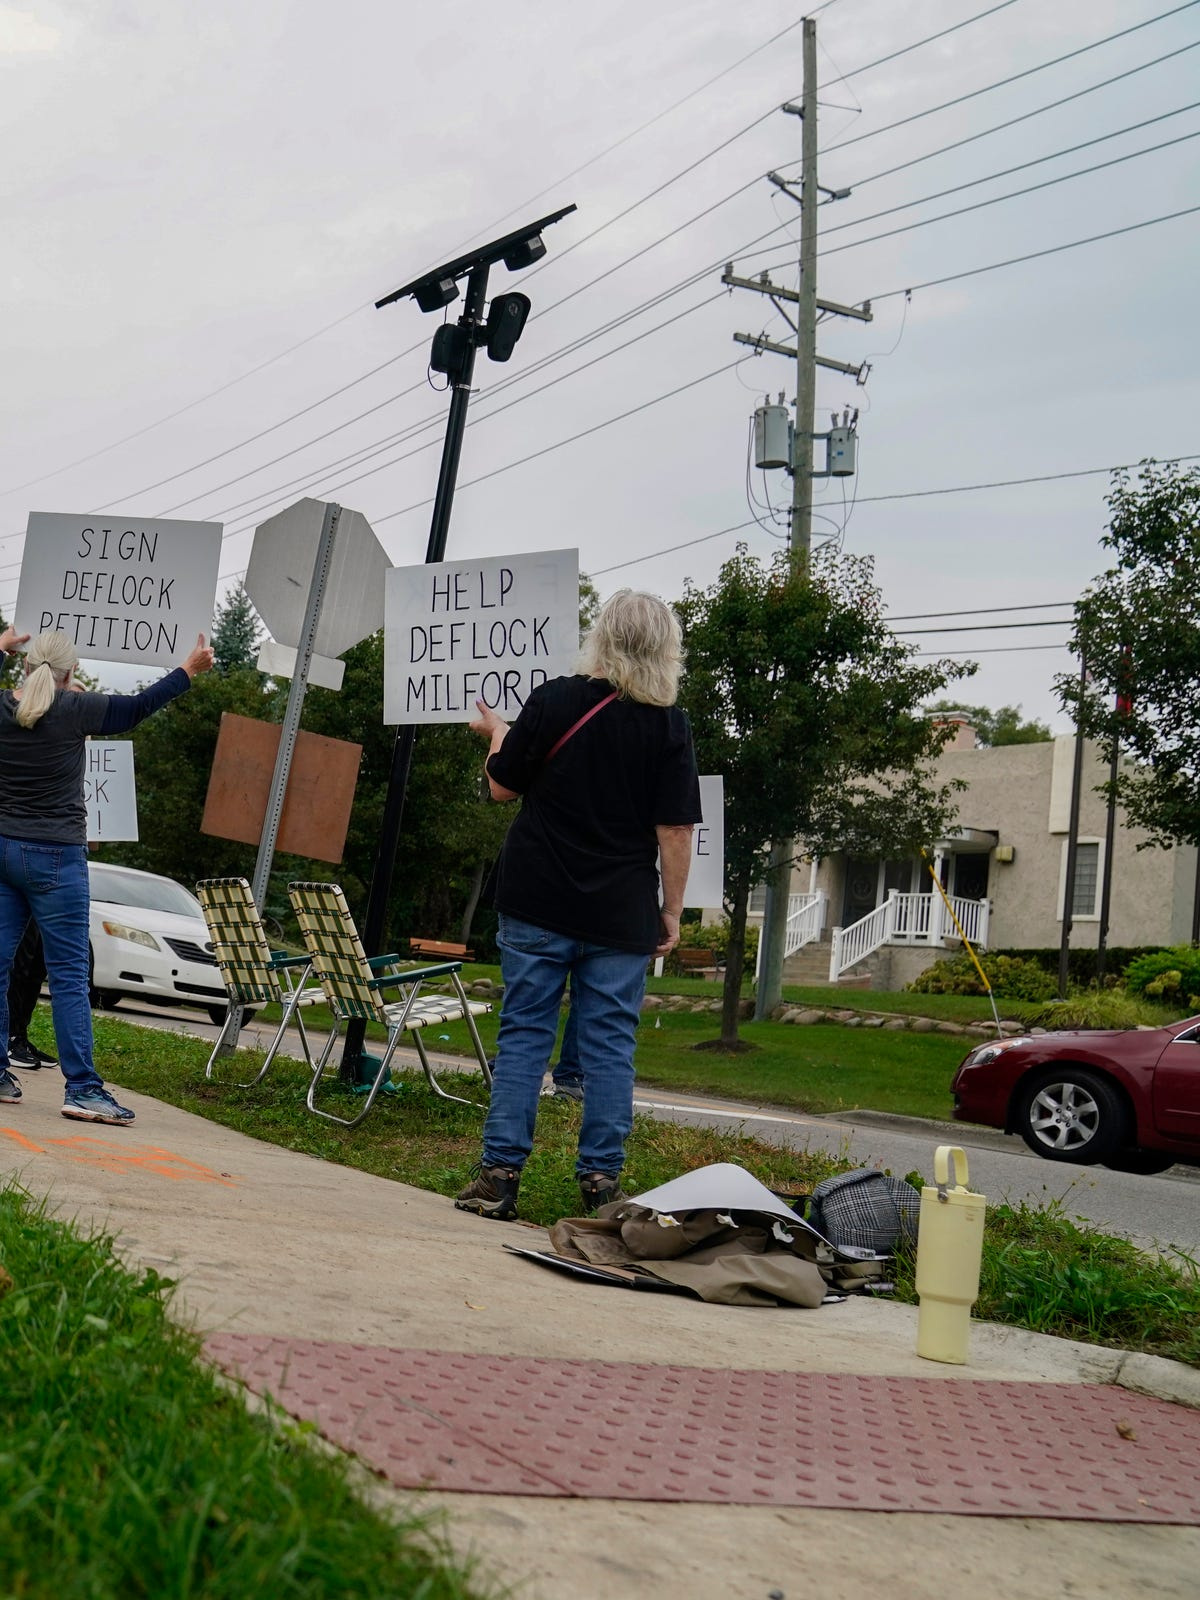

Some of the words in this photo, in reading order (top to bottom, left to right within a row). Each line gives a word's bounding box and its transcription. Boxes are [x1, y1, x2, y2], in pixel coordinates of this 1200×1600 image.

[77, 528, 159, 563] SIGN
[61, 570, 175, 610] DEFLOCK
[431, 568, 514, 612] HELP
[410, 616, 550, 663] DEFLOCK
